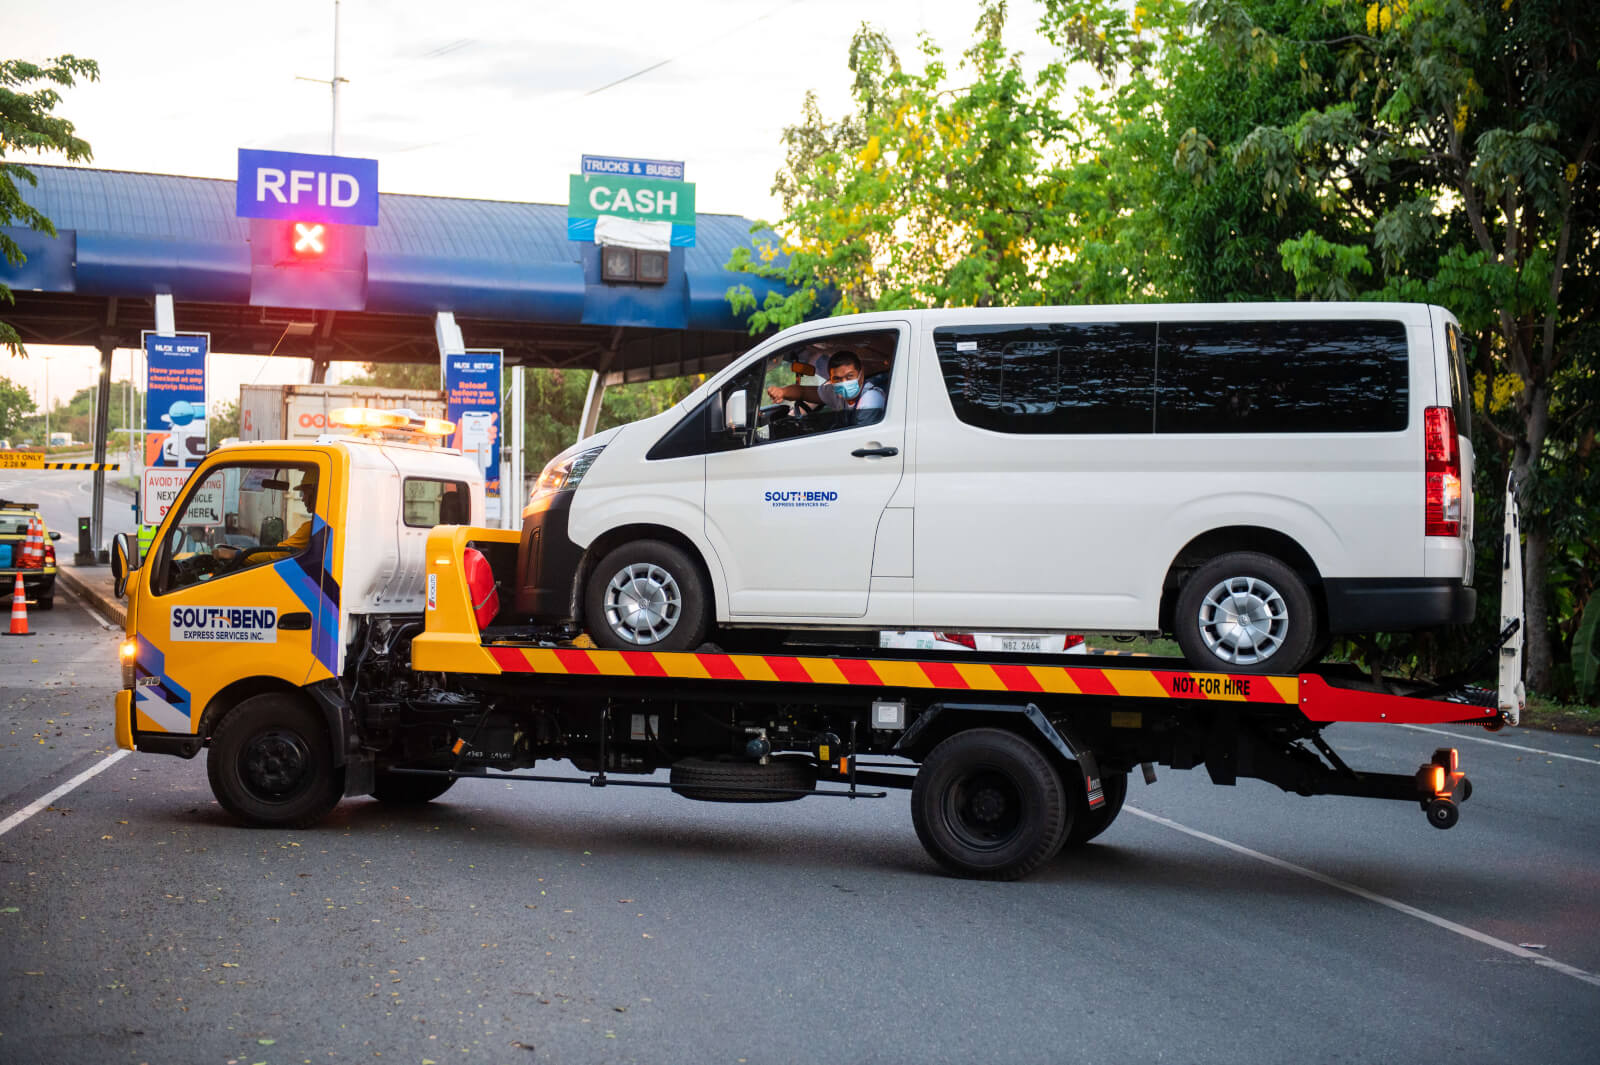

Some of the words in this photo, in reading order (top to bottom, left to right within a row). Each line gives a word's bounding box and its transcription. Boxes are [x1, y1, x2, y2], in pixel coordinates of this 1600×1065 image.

[585, 159, 629, 173] TRUCKS
[632, 163, 641, 173] &
[645, 164, 681, 177] BUSES
[256, 167, 360, 208] RFID
[589, 186, 678, 216] CASH
[186, 368, 203, 376] RFID
[459, 381, 487, 390] Reload
[452, 389, 478, 397] before
[479, 390, 494, 399] you
[149, 476, 173, 488] AVOID
[157, 490, 177, 501] NEXT
[764, 491, 838, 502] SOUTHBEND
[188, 508, 210, 518] HERE
[172, 607, 276, 629] SOUTHBEND
[183, 630, 215, 640] EXPRESS
[215, 631, 249, 641] SERVICES
[250, 632, 264, 641] INC.
[1173, 677, 1195, 693] NOT
[1199, 678, 1221, 695] FOR
[1224, 679, 1251, 696] HIRE
